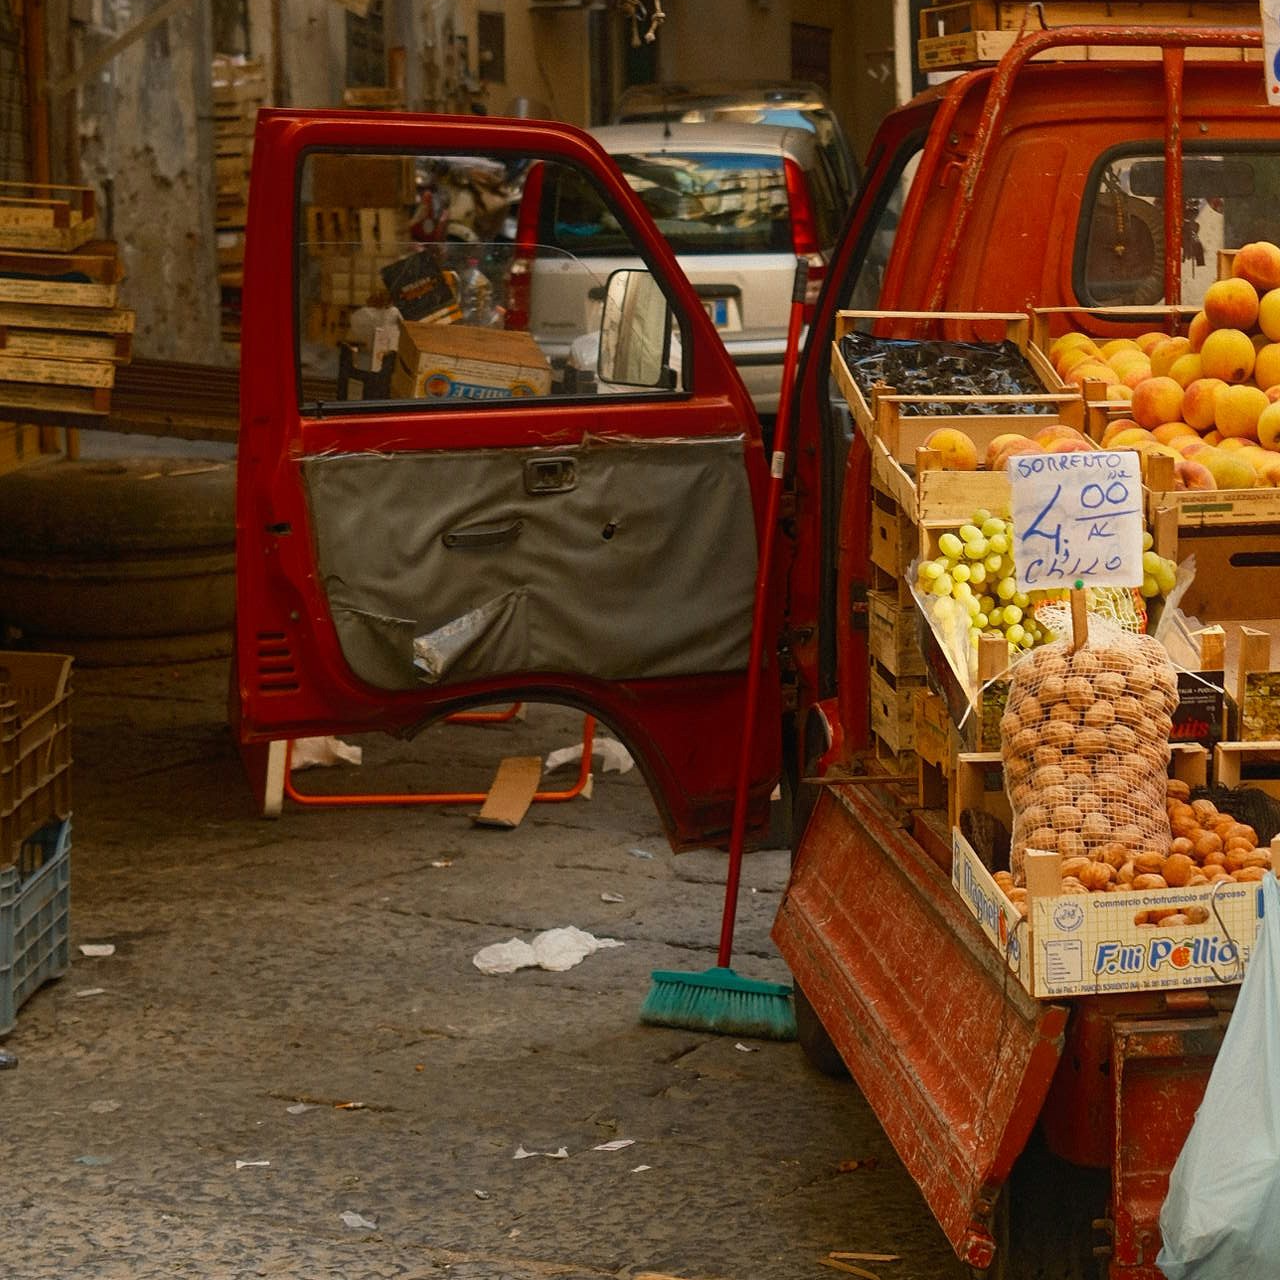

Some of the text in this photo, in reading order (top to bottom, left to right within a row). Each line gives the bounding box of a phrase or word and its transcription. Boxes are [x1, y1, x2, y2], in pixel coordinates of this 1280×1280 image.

[1018, 454, 1121, 477] SORRENTO
[1092, 897, 1141, 909] Commercio
[1142, 892, 1197, 906] Ortofrutticolo
